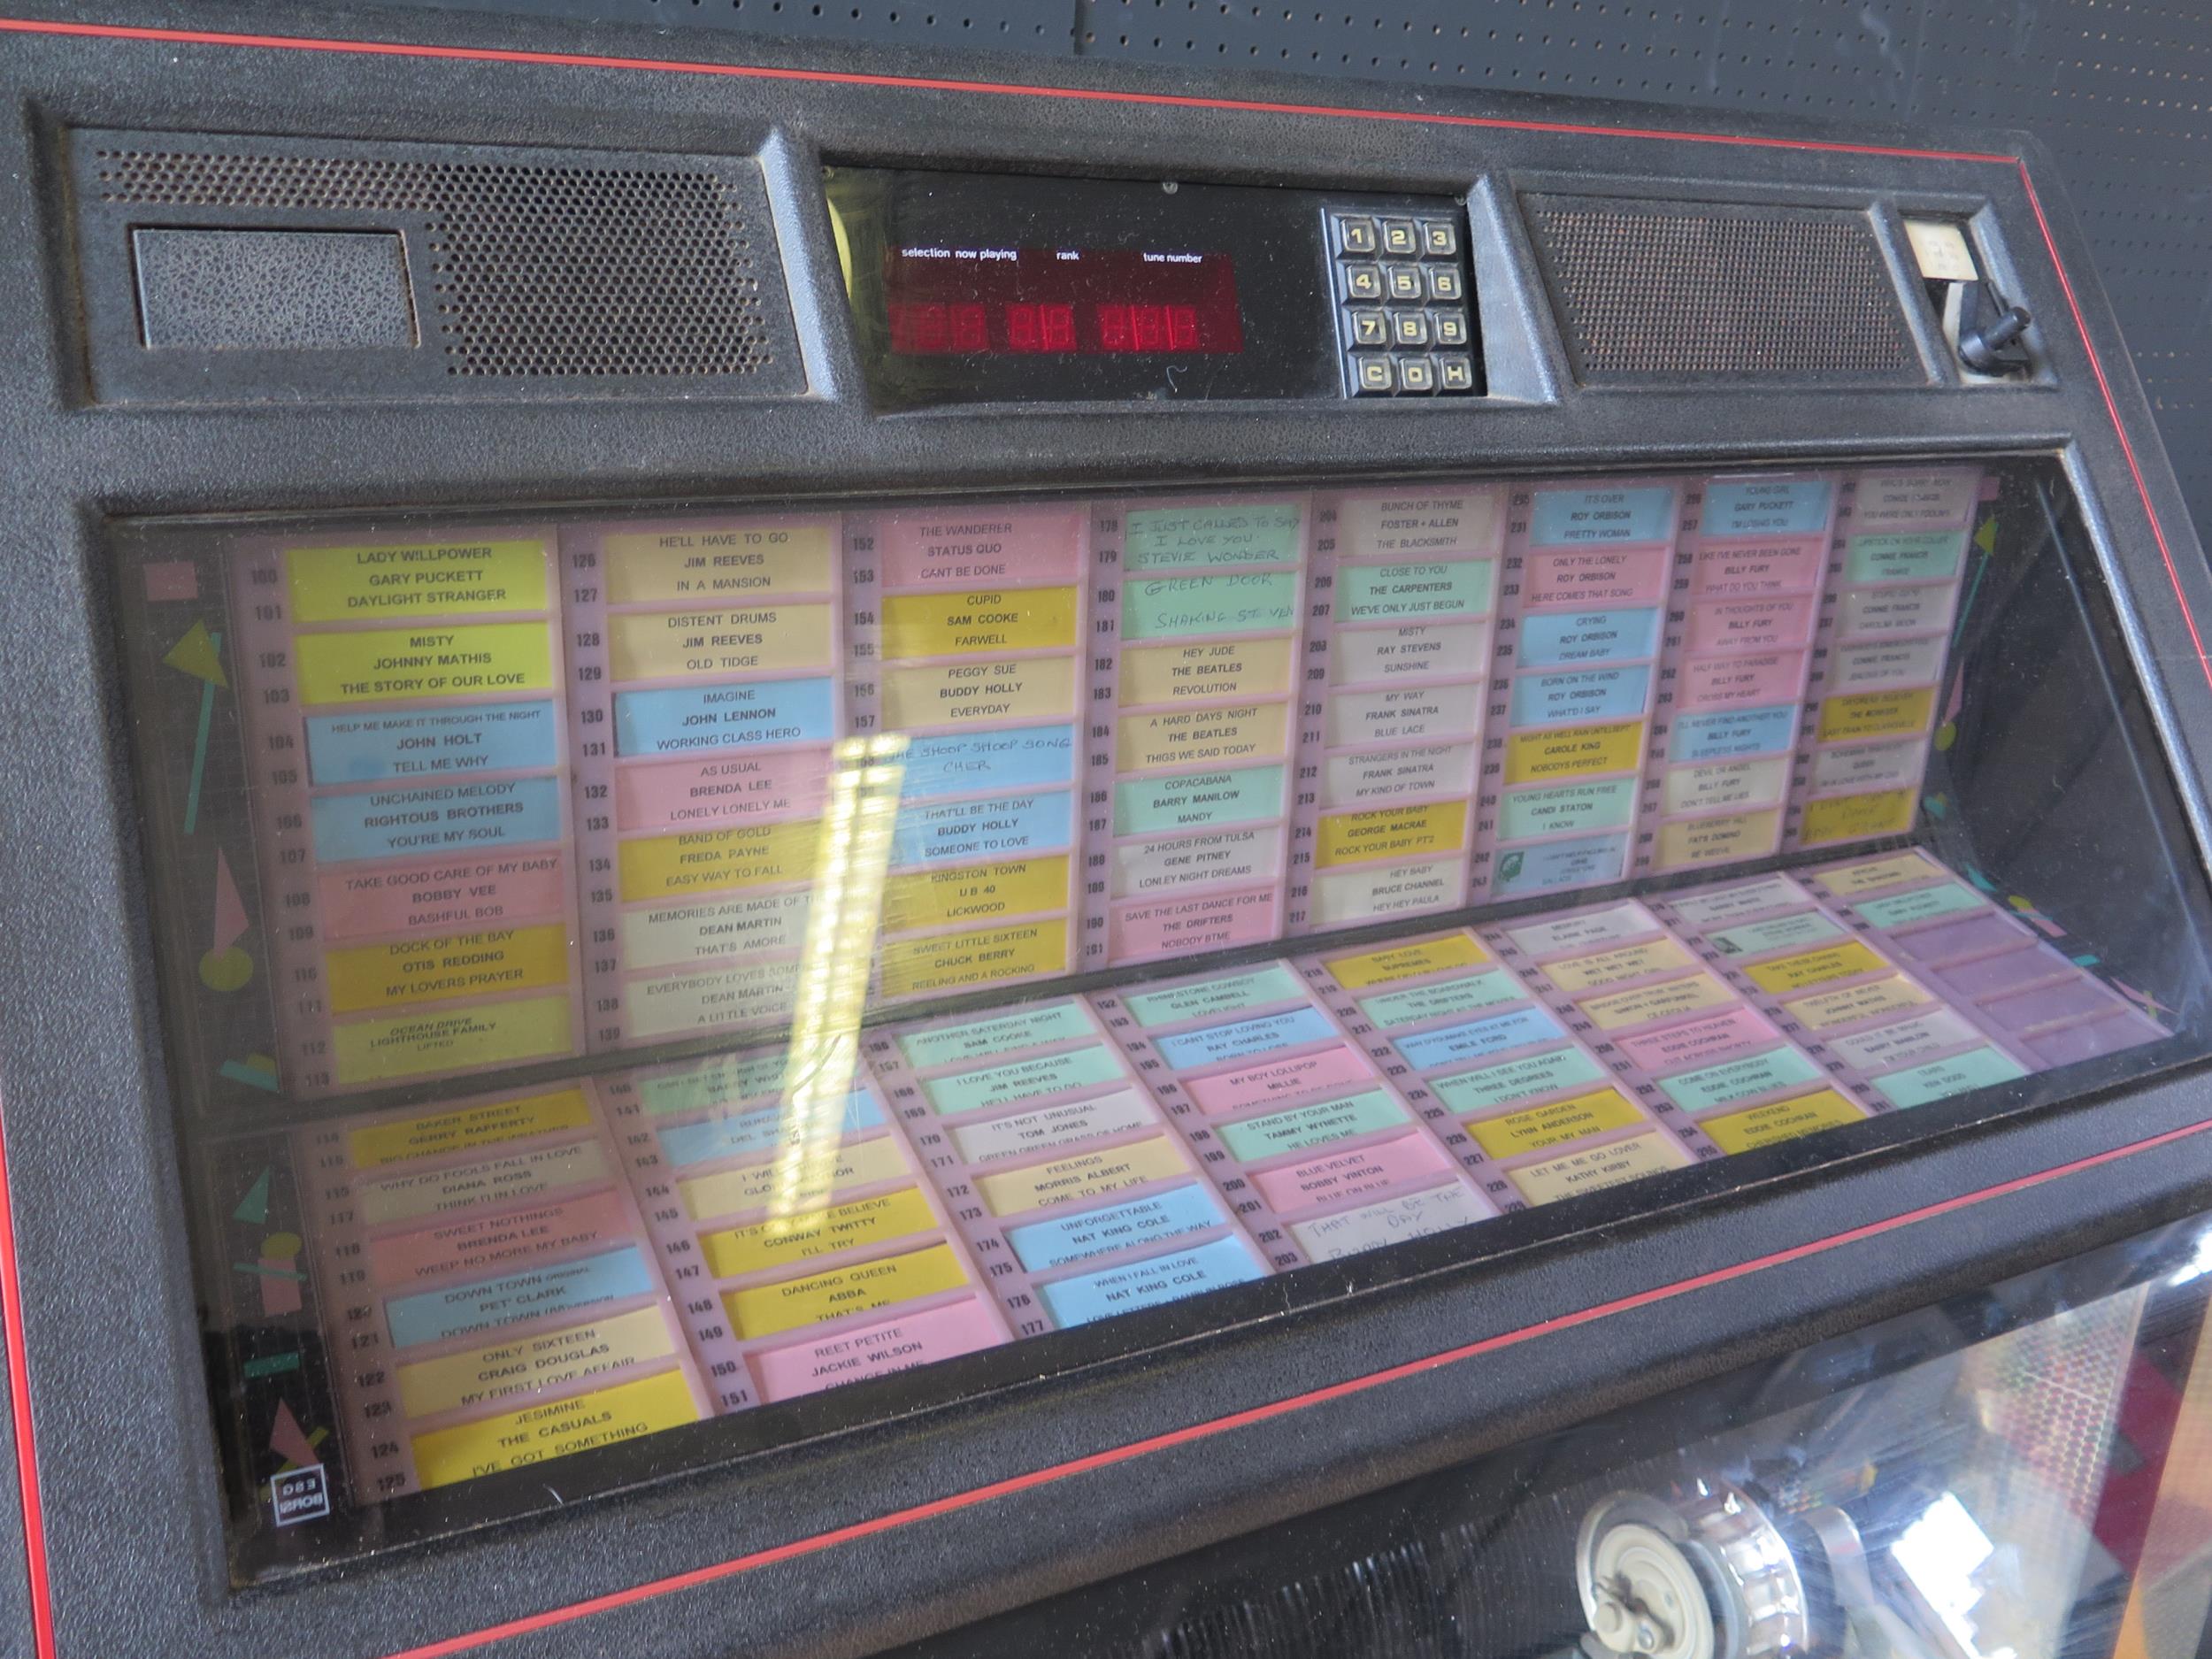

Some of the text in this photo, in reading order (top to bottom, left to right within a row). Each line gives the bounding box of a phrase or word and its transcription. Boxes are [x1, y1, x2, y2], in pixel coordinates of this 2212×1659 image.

[1351, 228, 1362, 243] 1
[1391, 230, 1406, 245] 2
[1432, 231, 1447, 245] 3
[902, 249, 1017, 261] selection now playing
[1056, 250, 1079, 261] rank
[1144, 252, 1202, 264] tune number
[1356, 274, 1371, 289] 4
[1397, 276, 1411, 290] 5
[1438, 277, 1451, 291] 6
[1363, 320, 1375, 335] 7
[1403, 321, 1417, 336] 8
[1443, 322, 1456, 336] 9
[1367, 366, 1382, 380] C
[1448, 366, 1463, 381] H
[1594, 511, 1631, 519] ORBISON
[1381, 520, 1418, 529] FOSTER
[659, 533, 788, 548] HE'LL HAVE TO GO
[357, 548, 492, 565] LADY WILLPOWER
[928, 544, 1002, 557] STATUS QUO
[685, 554, 764, 569] JIM REEVES
[370, 570, 483, 586] GARY PUCKETT
[677, 577, 771, 591] IN A MANSION
[575, 589, 597, 602] 127
[1371, 582, 1452, 595] THE CARPENTERS
[348, 589, 506, 608] DAYLIGHT STRANGER
[967, 595, 1001, 605] CUPID
[668, 612, 776, 628] DISTENT DRUMS
[947, 613, 1018, 626] SAM COOKE
[410, 635, 453, 648] MISTY
[577, 634, 599, 646] 128
[682, 634, 763, 649] JIM REEVES
[956, 634, 1007, 646] FARWELL
[1183, 646, 1235, 657] HEY JUDE
[1378, 642, 1441, 655] RAY STEVENS
[373, 653, 492, 670] JOHNNY MATHIS
[687, 656, 758, 670] OLD TIDGE
[1095, 658, 1112, 670] 182
[949, 664, 1017, 679] PEGGY SUE
[1172, 664, 1241, 676] THE BEATLES
[342, 673, 525, 695] THE STORY OF OUR LOVE
[940, 683, 1022, 698] BUDDY HOLLY
[1173, 682, 1236, 695] REVOLUTION
[703, 690, 755, 704] IMAGINE
[682, 708, 776, 726] JOHN LENNON
[951, 704, 1010, 718] EVERYDAY
[1366, 707, 1439, 720] FRANK SINATRA
[657, 727, 801, 750] WORKING CLASS HERO
[1375, 725, 1425, 737] BLUE LACE
[396, 733, 482, 749] JOHN HOLT
[583, 742, 605, 757] 131
[394, 756, 488, 773] TELL ME WHY
[690, 780, 772, 798] BRENDA LEE
[1154, 791, 1240, 808] BARRY MANILOW
[365, 802, 524, 828] RIGHTOUS BROTHERS
[1178, 812, 1212, 824] MANDY
[1348, 820, 1426, 837] GEORGE MACRAE
[680, 846, 769, 864] FREDA PAYNE
[412, 885, 496, 903] BOBBY VEE
[700, 918, 781, 936] DEAN MARTIN
[403, 951, 504, 973] OTIS REDDING
[1018, 1120, 1087, 1140] TOM JONES
[1265, 1114, 1357, 1141] TAMMY WYNETTE
[1510, 1110, 1594, 1139] LYNN ANDERSON
[1047, 1156, 1102, 1175] FEELINGS
[1296, 1154, 1365, 1177] BLUE VELVET
[1565, 1160, 1631, 1184] KATHY KIRBY
[1035, 1164, 1130, 1192] MORRIS ALBERT
[1301, 1164, 1384, 1192] BOBBY VINTON
[960, 1207, 982, 1221] 173
[764, 1217, 876, 1249] CONWAY TWITTY
[1071, 1215, 1170, 1244] NAT KING COLE
[989, 1263, 1012, 1278] 175
[781, 1264, 897, 1297] DANCING QUEEN
[828, 1289, 866, 1303] ABBA
[483, 1329, 595, 1363] ONLY SIXTEEN
[815, 1329, 902, 1358] REET PETITE
[478, 1344, 610, 1381] CRAIG DOUGLAS
[812, 1342, 922, 1378] JACKIE WILSON
[498, 1412, 612, 1448] THE CASUALS
